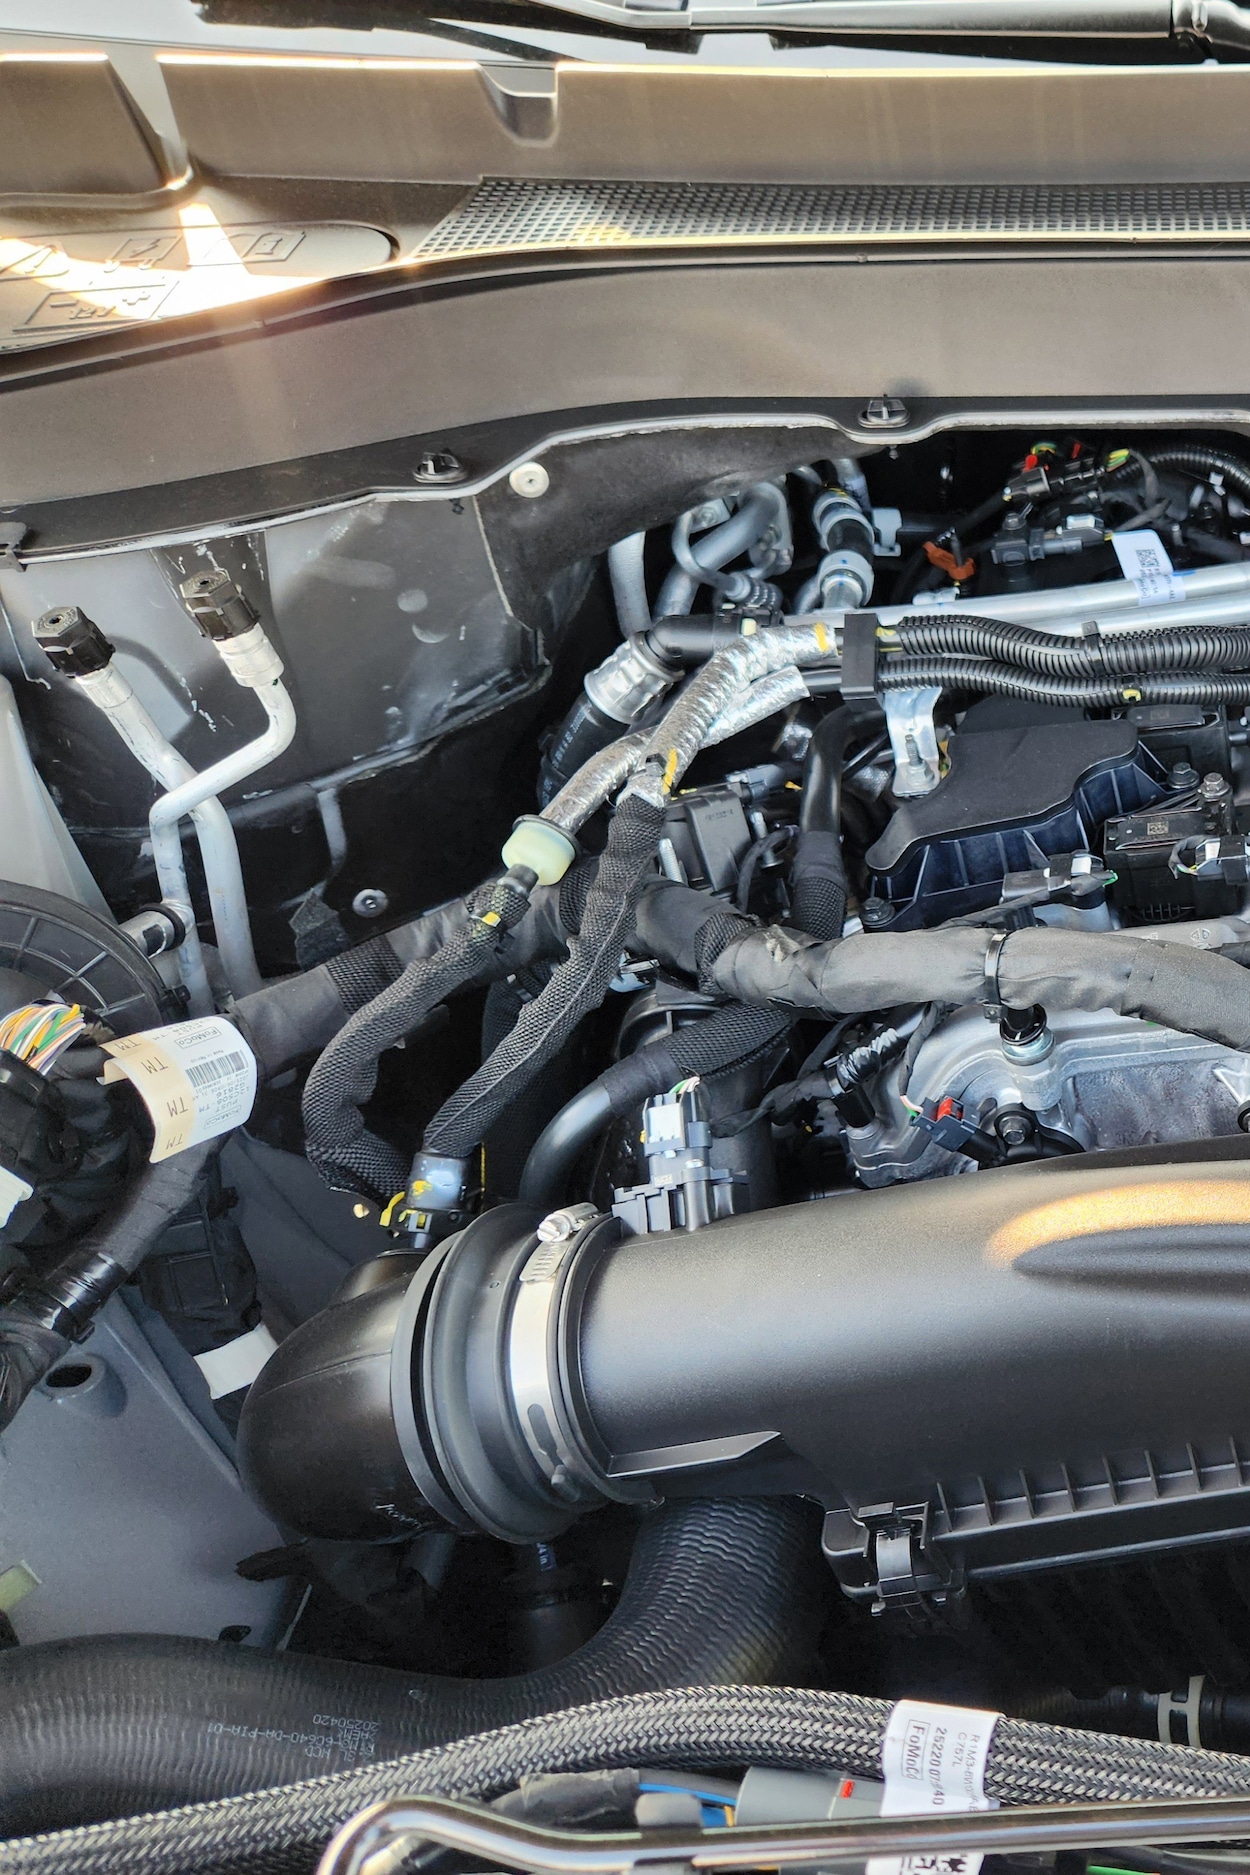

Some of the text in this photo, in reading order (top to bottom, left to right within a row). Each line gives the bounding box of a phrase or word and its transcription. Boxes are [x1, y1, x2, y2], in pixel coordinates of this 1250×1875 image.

[114, 1038, 142, 1051] TM
[140, 1056, 169, 1075] TM
[166, 1096, 188, 1118] TM
[165, 1133, 184, 1150] TM
[313, 1713, 380, 1731] 20250420
[304, 1745, 331, 1760] HCD
[905, 1724, 926, 1780] FoMoCo
[928, 1726, 948, 1767] 25220
